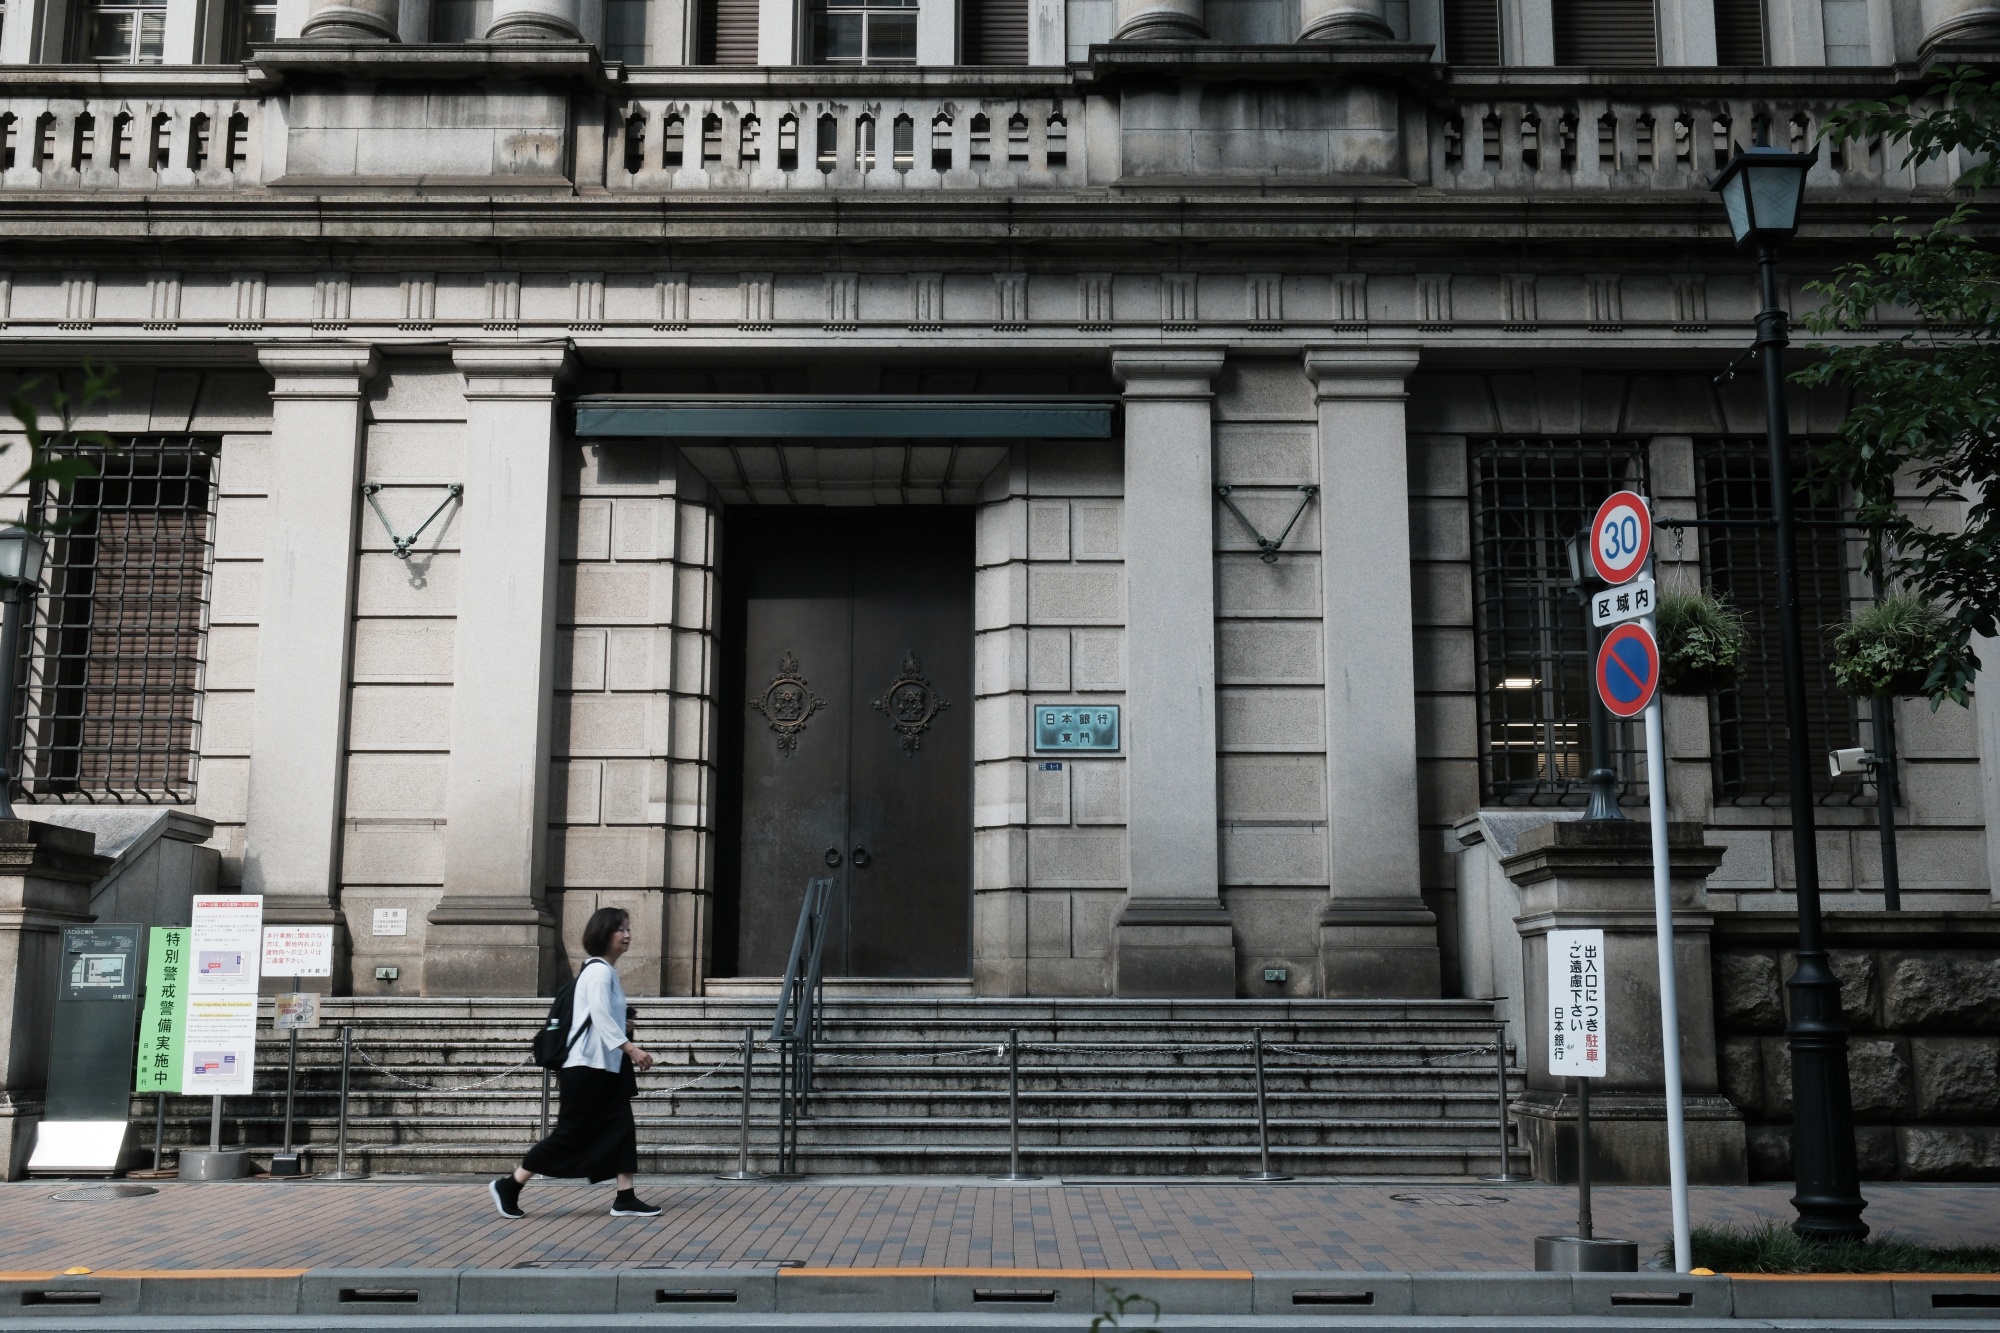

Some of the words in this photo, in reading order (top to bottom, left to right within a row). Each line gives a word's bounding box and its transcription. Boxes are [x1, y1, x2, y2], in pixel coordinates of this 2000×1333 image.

[1605, 515, 1637, 560] 30
[1598, 588, 1649, 619] 区域内
[1046, 713, 1108, 725] 日本銀行
[1062, 732, 1090, 744] 東門
[154, 932, 180, 1086] 特別警戒警備実施中
[1569, 944, 1583, 1032] ご遠慮下さい
[1584, 944, 1598, 1062] 出入口につき駐車
[1554, 1007, 1564, 1060] 日本銀行
